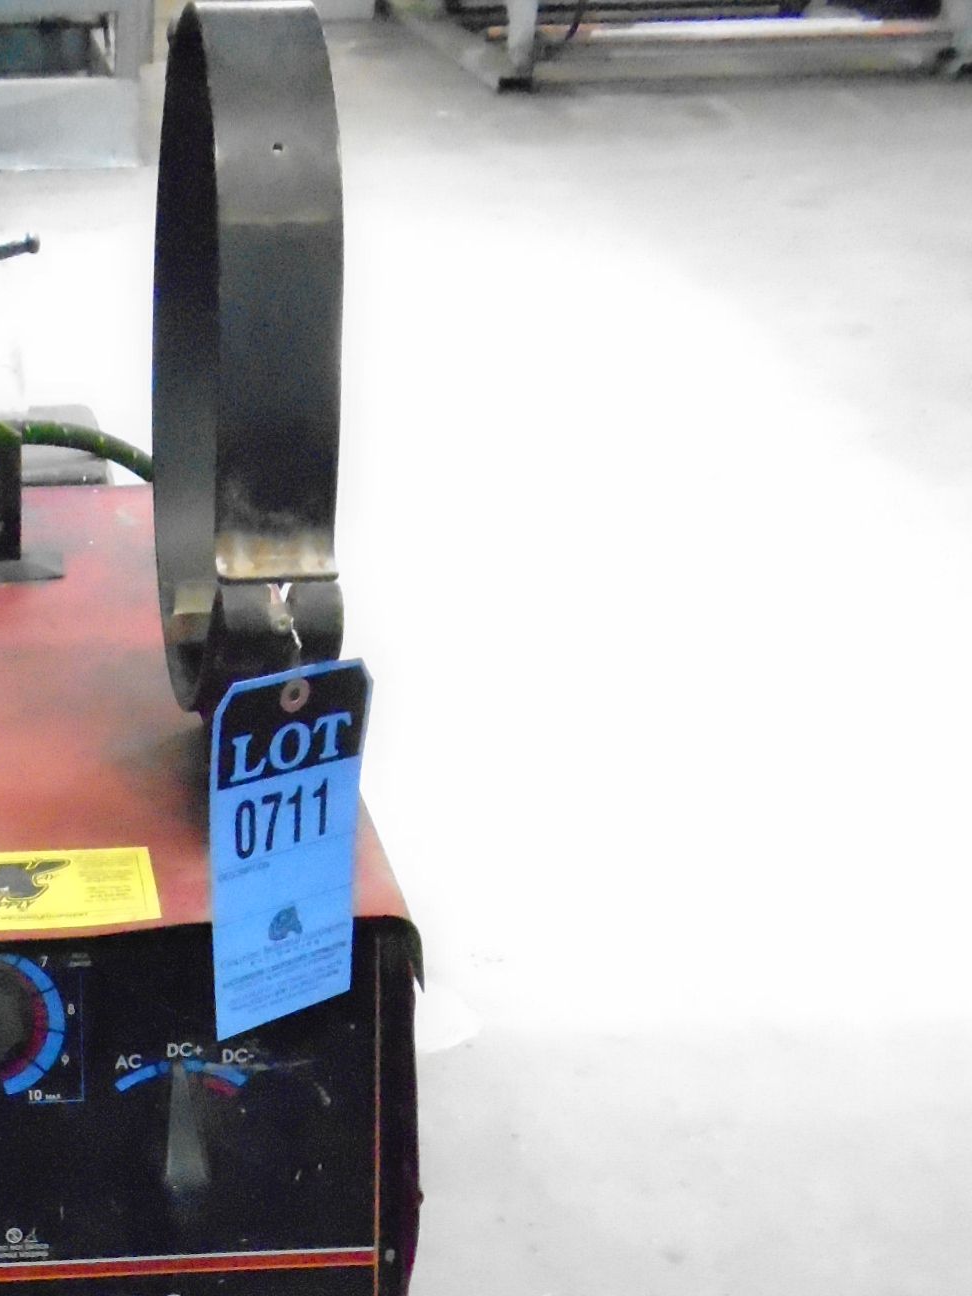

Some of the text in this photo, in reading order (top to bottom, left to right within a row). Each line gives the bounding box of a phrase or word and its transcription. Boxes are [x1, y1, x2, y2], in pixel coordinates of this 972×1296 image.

[230, 711, 353, 783] LOT
[235, 778, 328, 860] 0711
[40, 955, 48, 968] 7
[67, 1003, 76, 1015] 8
[166, 1042, 204, 1058] DC+
[222, 1048, 255, 1064] DC-
[61, 1054, 70, 1066] 9
[115, 1053, 142, 1070] AC
[28, 1089, 42, 1101] 10
